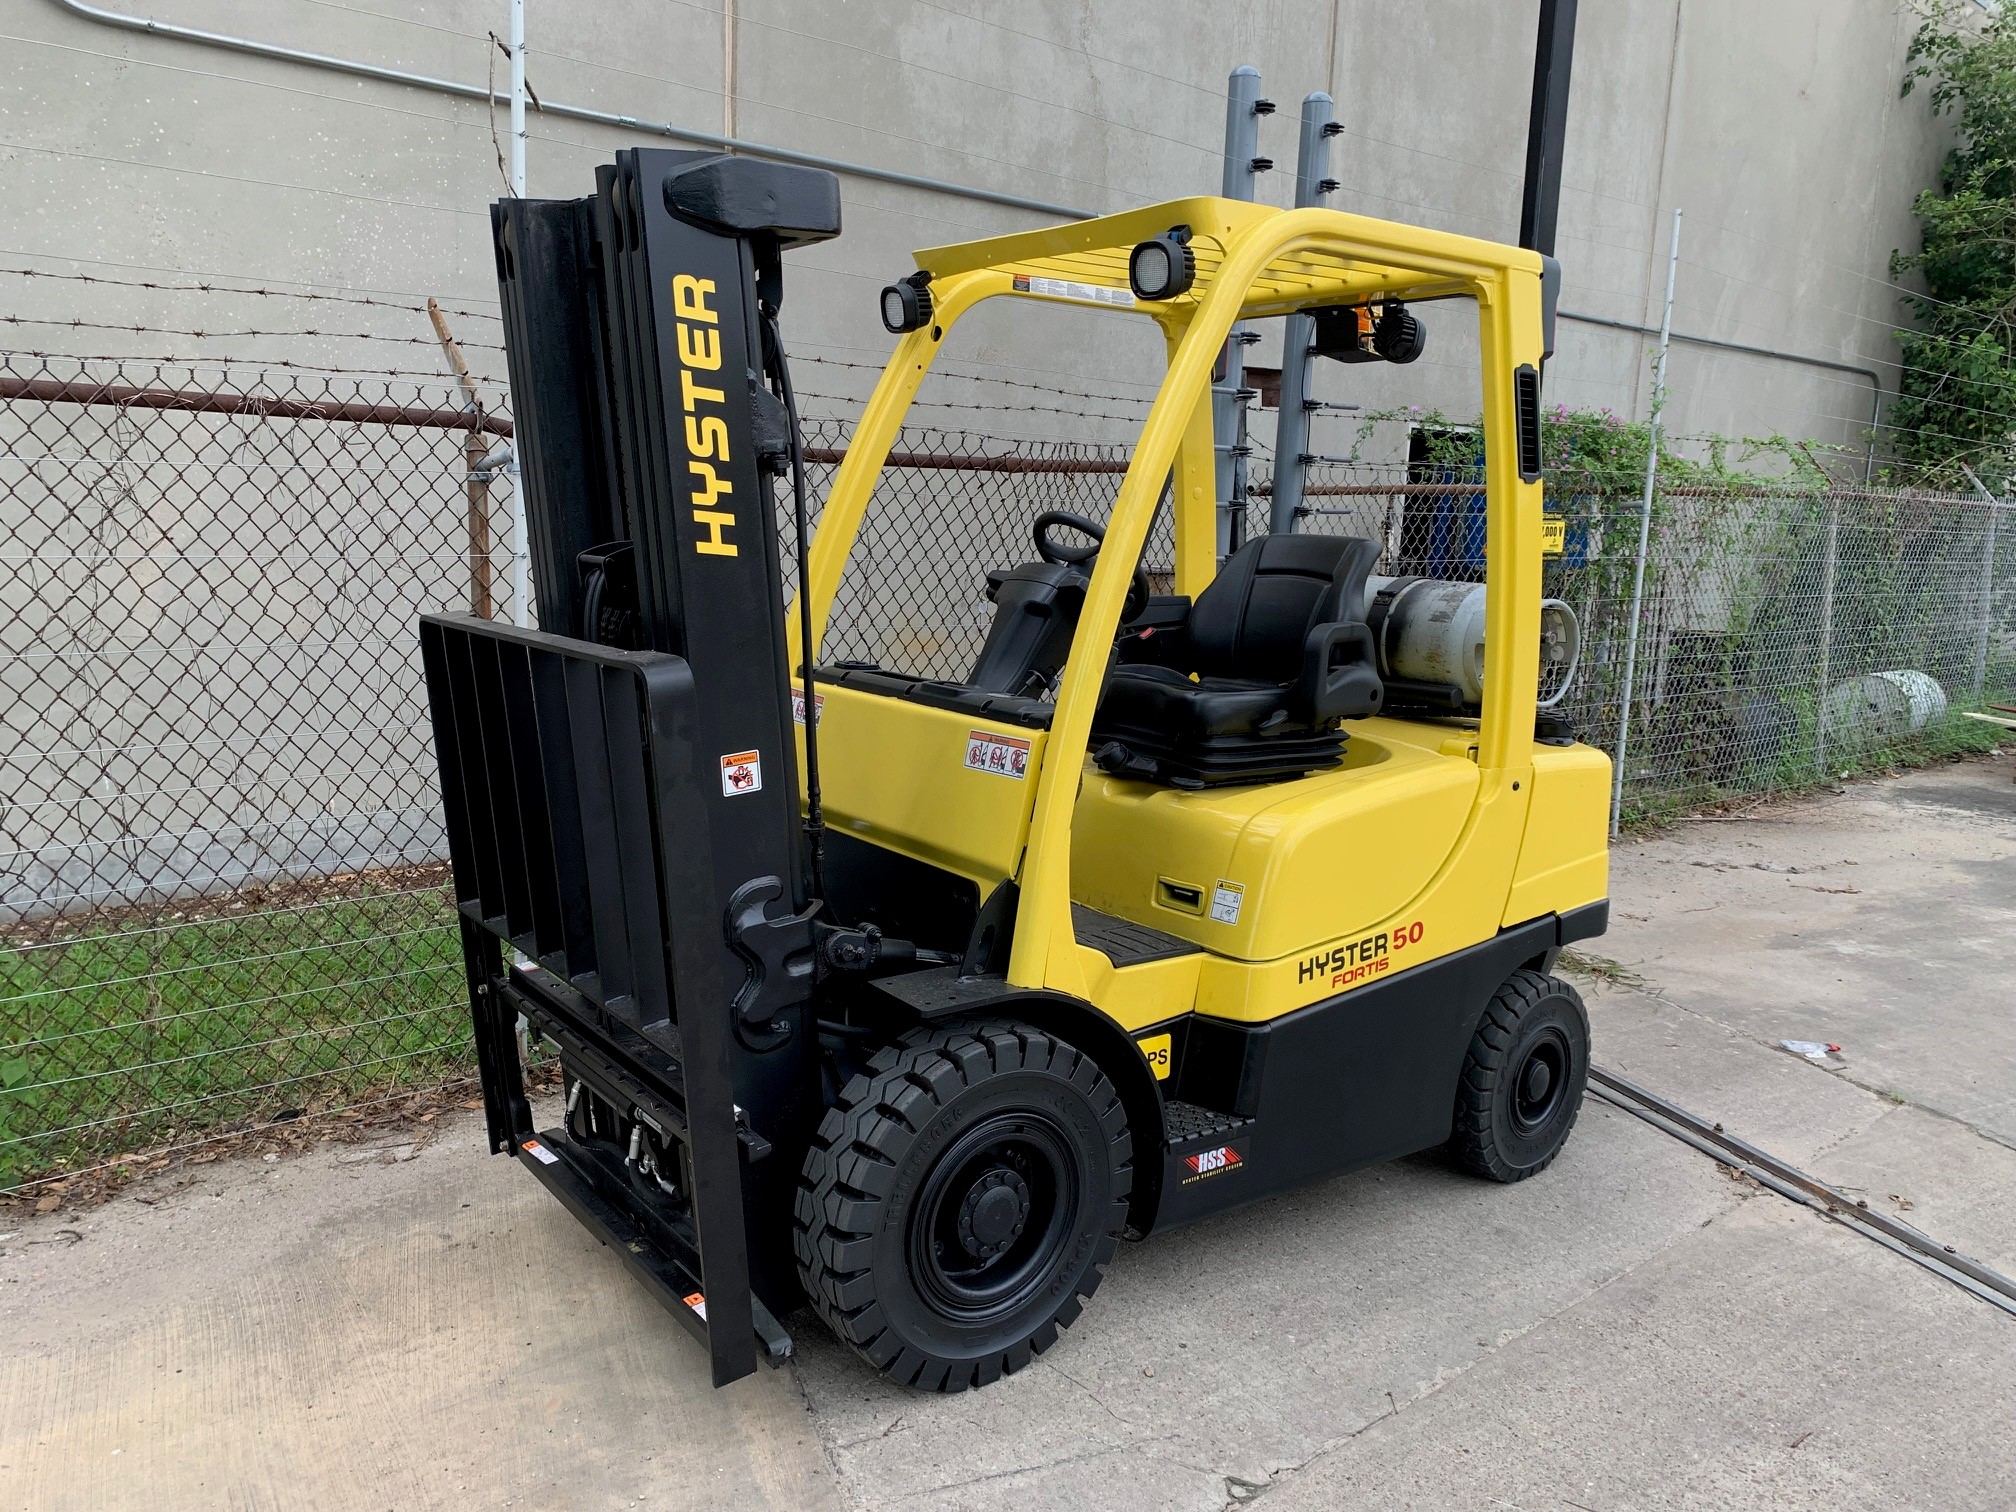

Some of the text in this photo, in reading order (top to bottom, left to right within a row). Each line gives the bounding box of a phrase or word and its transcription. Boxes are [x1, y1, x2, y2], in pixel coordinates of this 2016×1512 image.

[672, 274, 739, 557] HYSTER
[733, 755, 755, 763] WARNING
[1225, 883, 1241, 891] CAUTION
[1298, 921, 1424, 985] HYSTER 50
[1332, 957, 1390, 989] FORTIS
[883, 1104, 965, 1233] TRELLEBORG
[1183, 1162, 1243, 1185] HYSTER STABILITY SYSTEM
[1198, 1147, 1226, 1173] HSS
